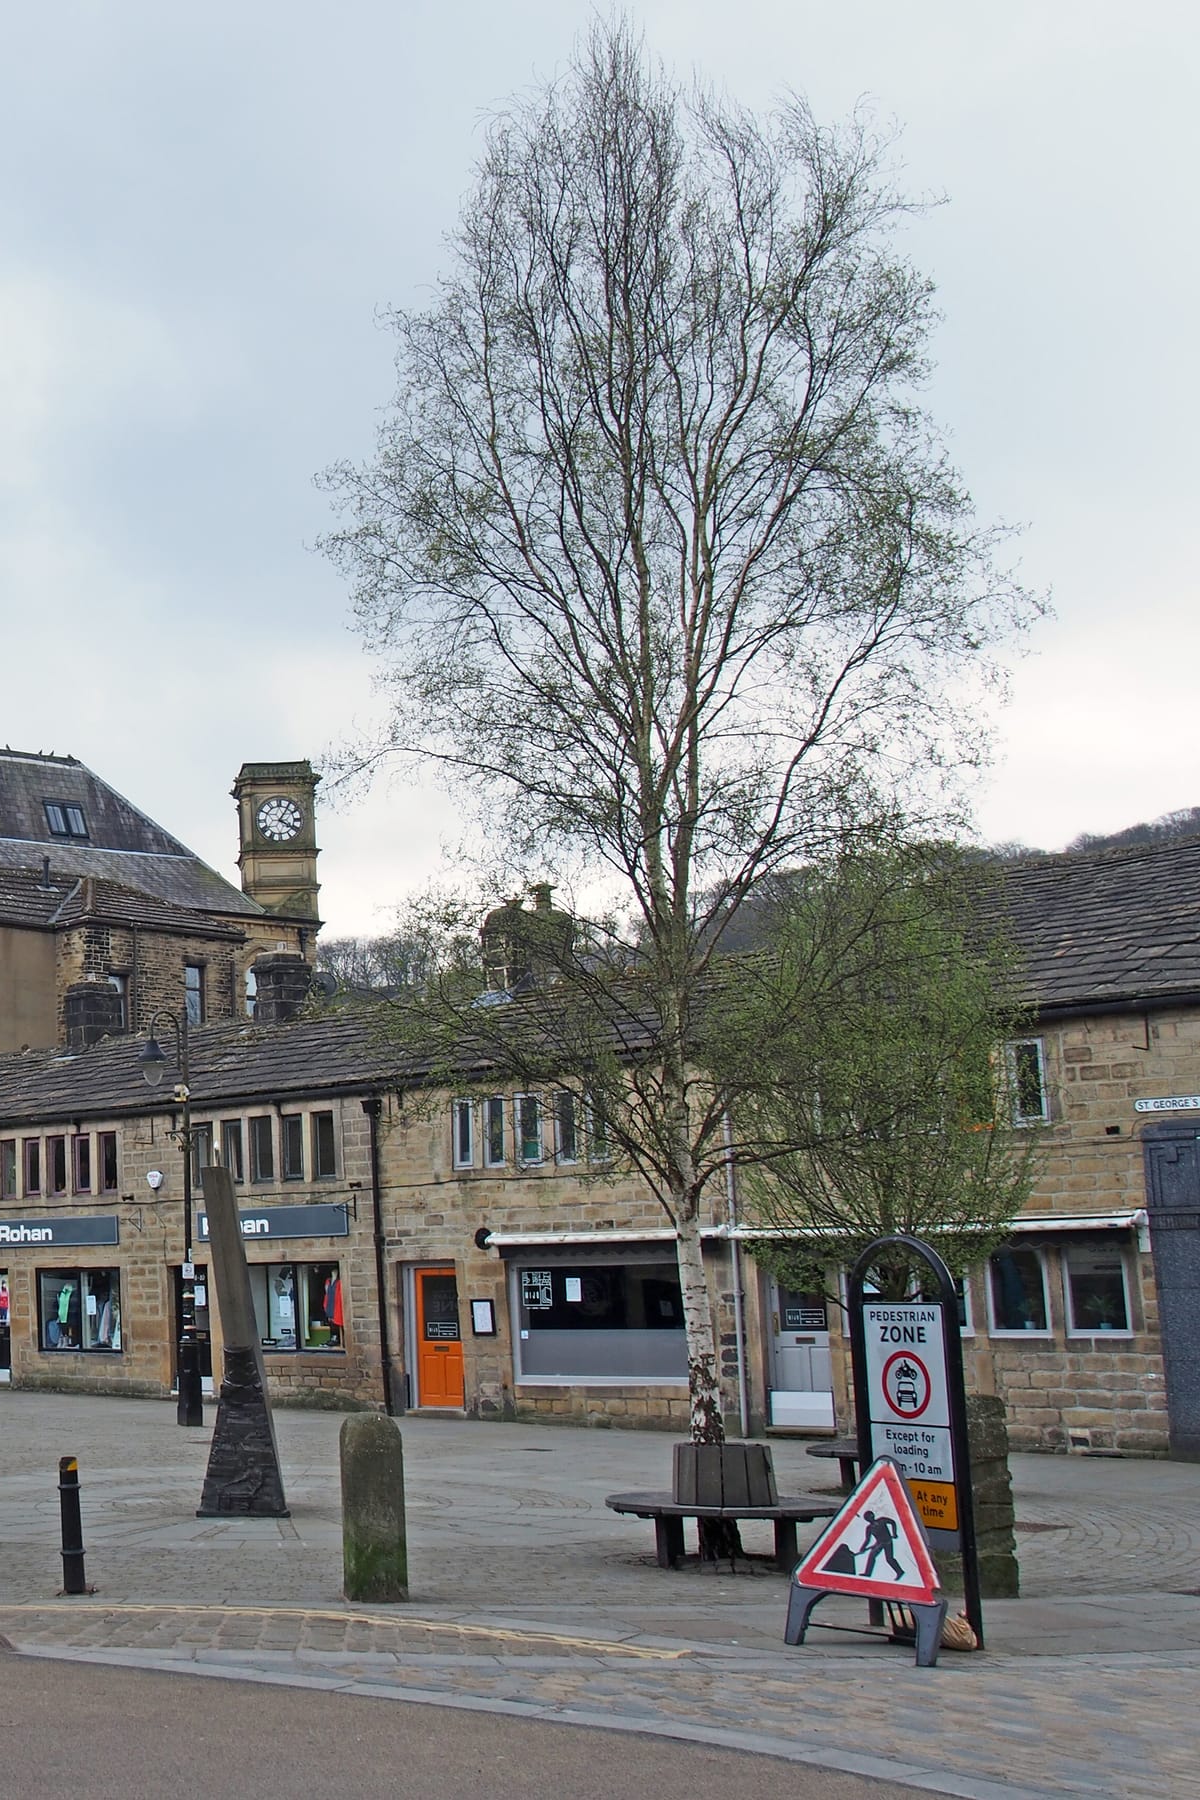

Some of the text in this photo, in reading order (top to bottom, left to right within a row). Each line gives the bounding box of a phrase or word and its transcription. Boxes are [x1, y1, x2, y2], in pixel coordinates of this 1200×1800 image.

[1153, 1098, 1199, 1109] GEORGE'S
[869, 1311, 936, 1322] PEDESTRIAN
[880, 1325, 927, 1343] ZONE
[886, 1429, 936, 1443] Except for
[893, 1443, 929, 1458] loading
[914, 1462, 926, 1473] 10
[927, 1465, 942, 1475] am
[917, 1490, 948, 1506] At any
[922, 1505, 945, 1518] time
